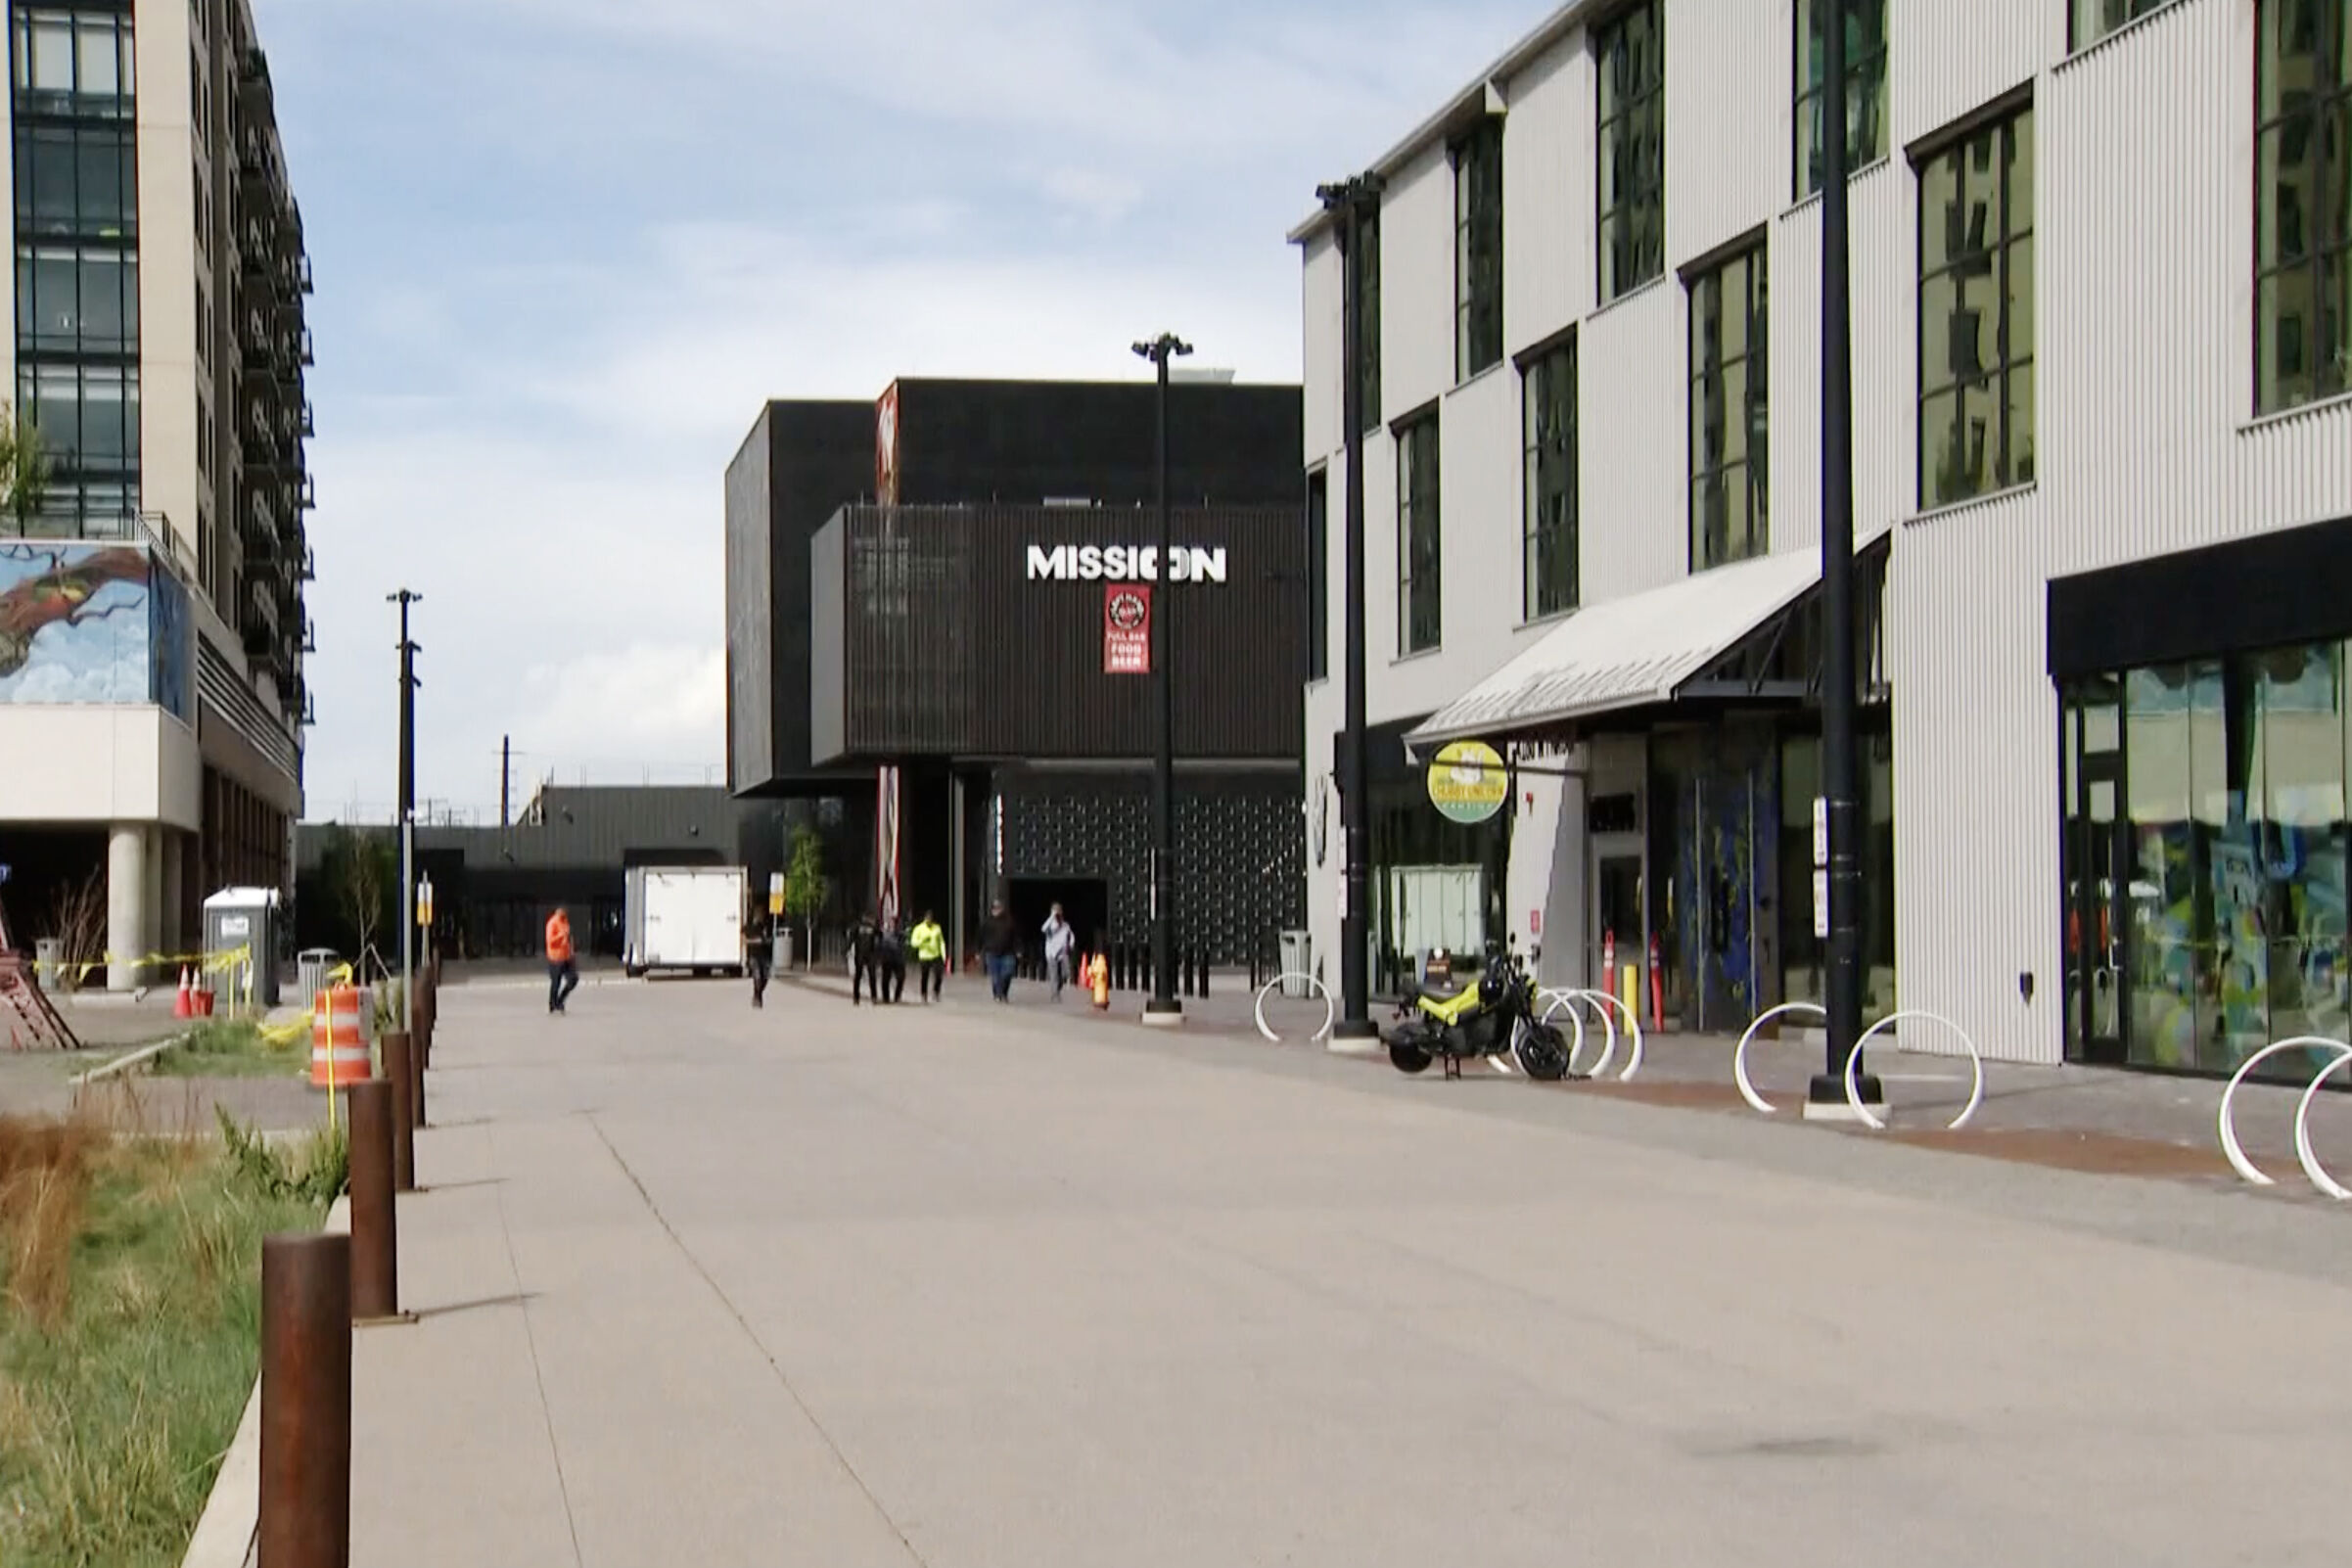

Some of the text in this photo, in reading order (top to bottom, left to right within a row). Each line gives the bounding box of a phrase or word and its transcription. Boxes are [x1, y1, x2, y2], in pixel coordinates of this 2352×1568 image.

[1027, 545, 1227, 582] MISSION
[1111, 643, 1142, 655] FOOD
[1111, 656, 1141, 668] BEER
